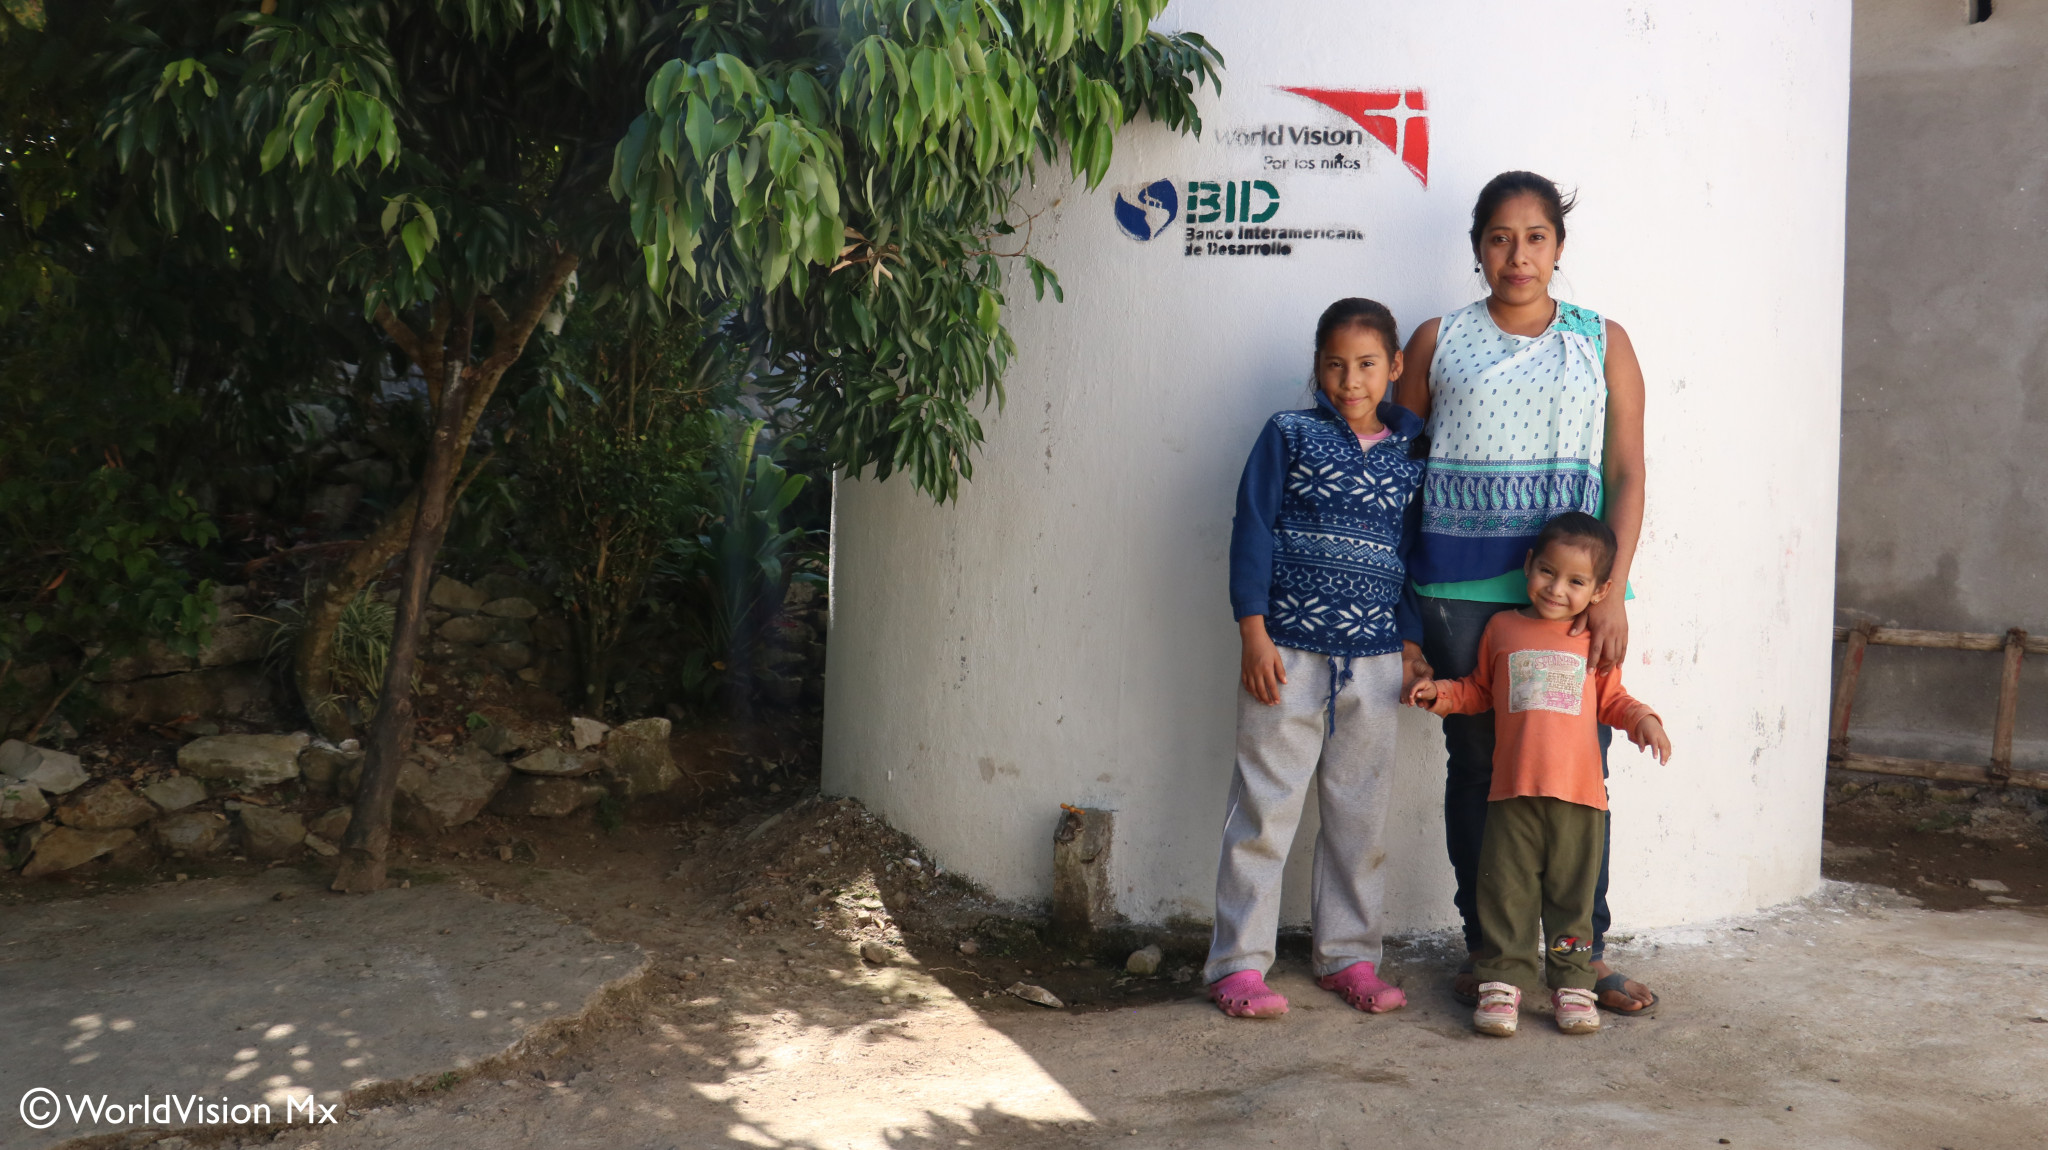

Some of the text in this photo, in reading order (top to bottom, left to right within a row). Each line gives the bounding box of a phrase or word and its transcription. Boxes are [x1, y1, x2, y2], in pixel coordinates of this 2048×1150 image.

[1214, 124, 1363, 146] World Vision
[1263, 155, 1288, 170] Por
[1294, 159, 1315, 169] los
[1186, 180, 1280, 223] BID
[1185, 227, 1233, 241] Banco
[1185, 242, 1292, 256] de Desarrollo
